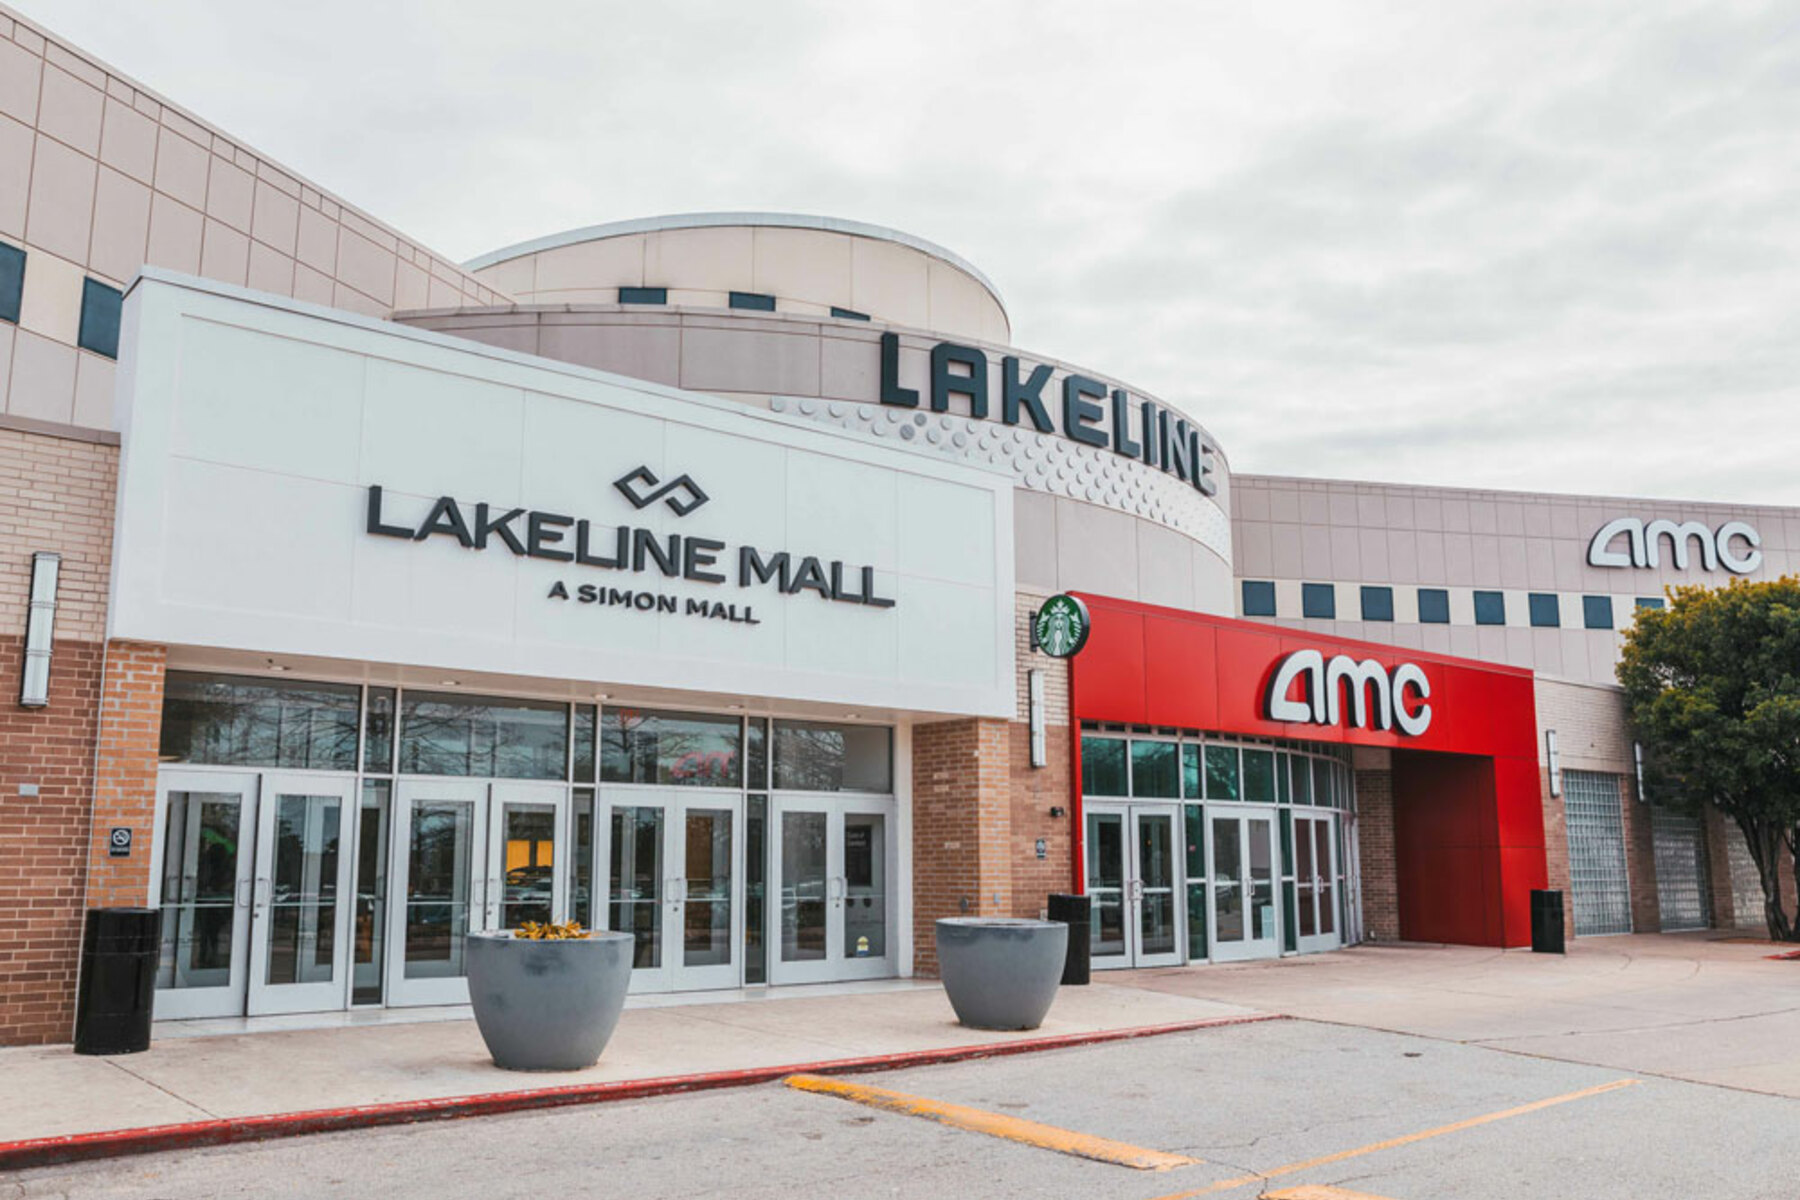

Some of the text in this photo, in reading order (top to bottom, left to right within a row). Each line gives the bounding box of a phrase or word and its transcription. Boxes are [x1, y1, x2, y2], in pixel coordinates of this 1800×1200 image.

[879, 330, 1217, 498] LAKELINE
[366, 484, 897, 609] LAKELINE MALL
[547, 580, 761, 625] A SIMON MALL
